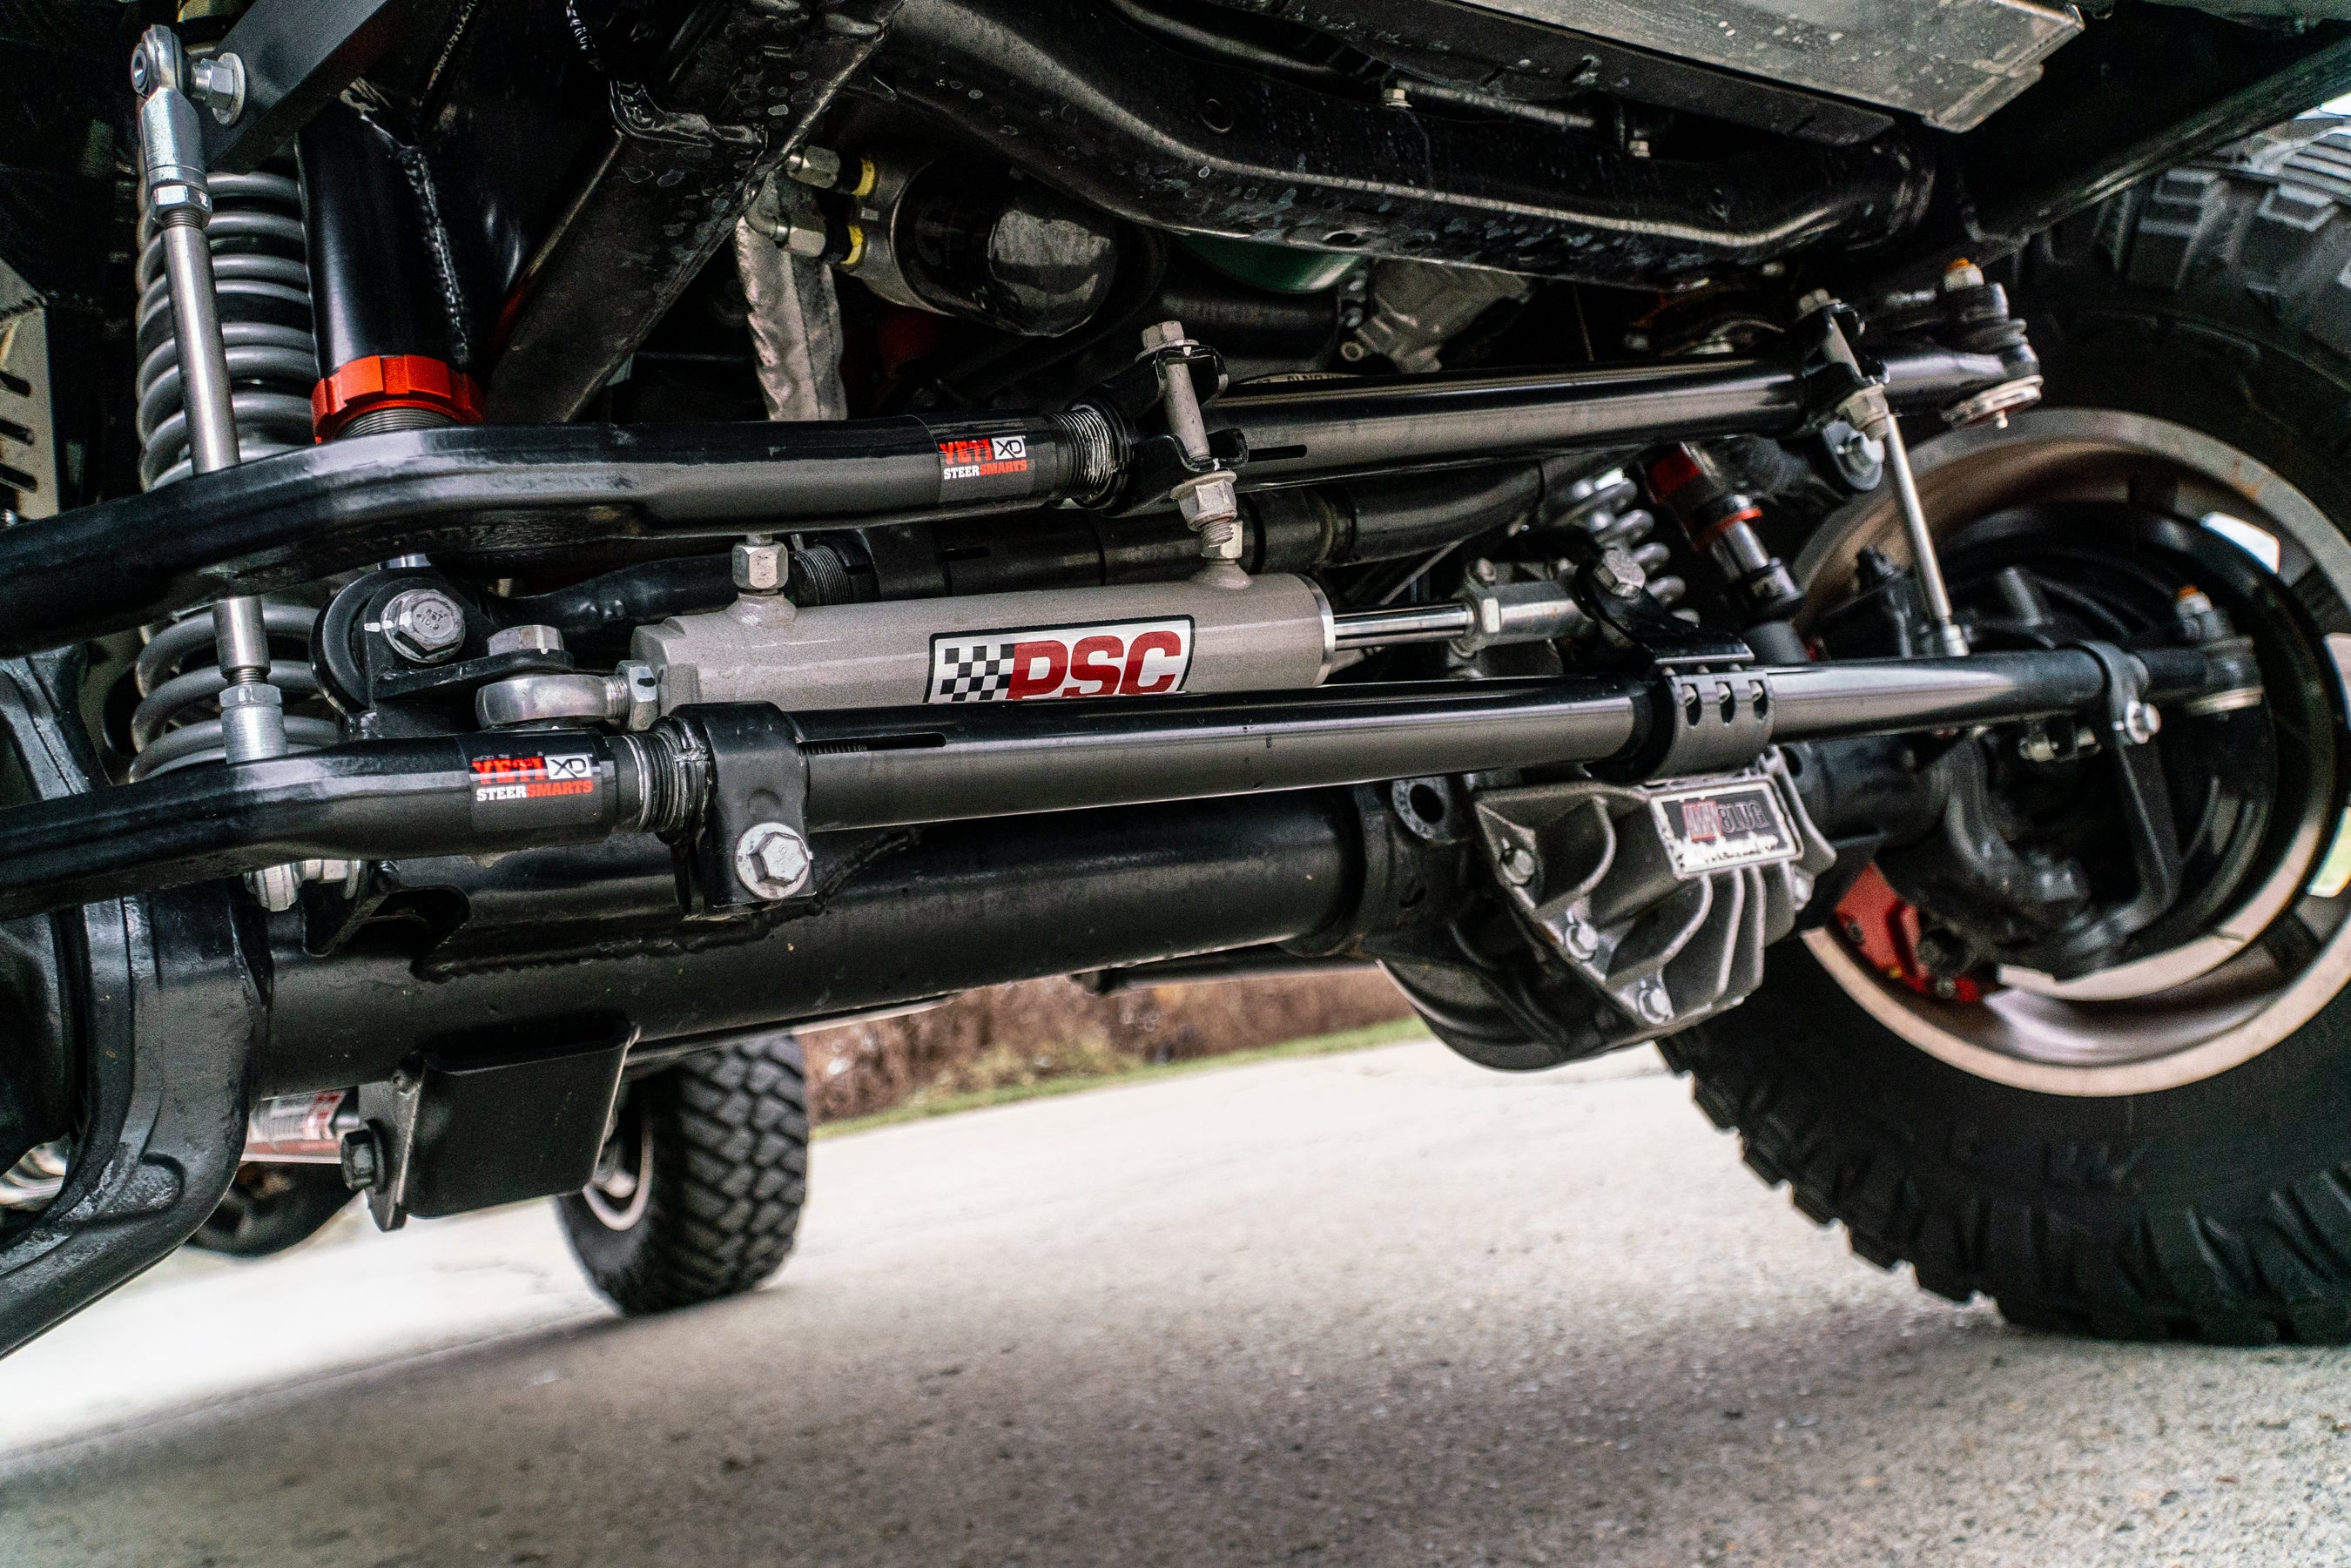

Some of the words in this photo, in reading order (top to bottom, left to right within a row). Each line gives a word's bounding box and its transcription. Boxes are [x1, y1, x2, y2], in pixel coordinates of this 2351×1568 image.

[939, 438, 994, 465] YETI
[1005, 630, 1182, 700] PSC
[471, 756, 546, 785] YETI
